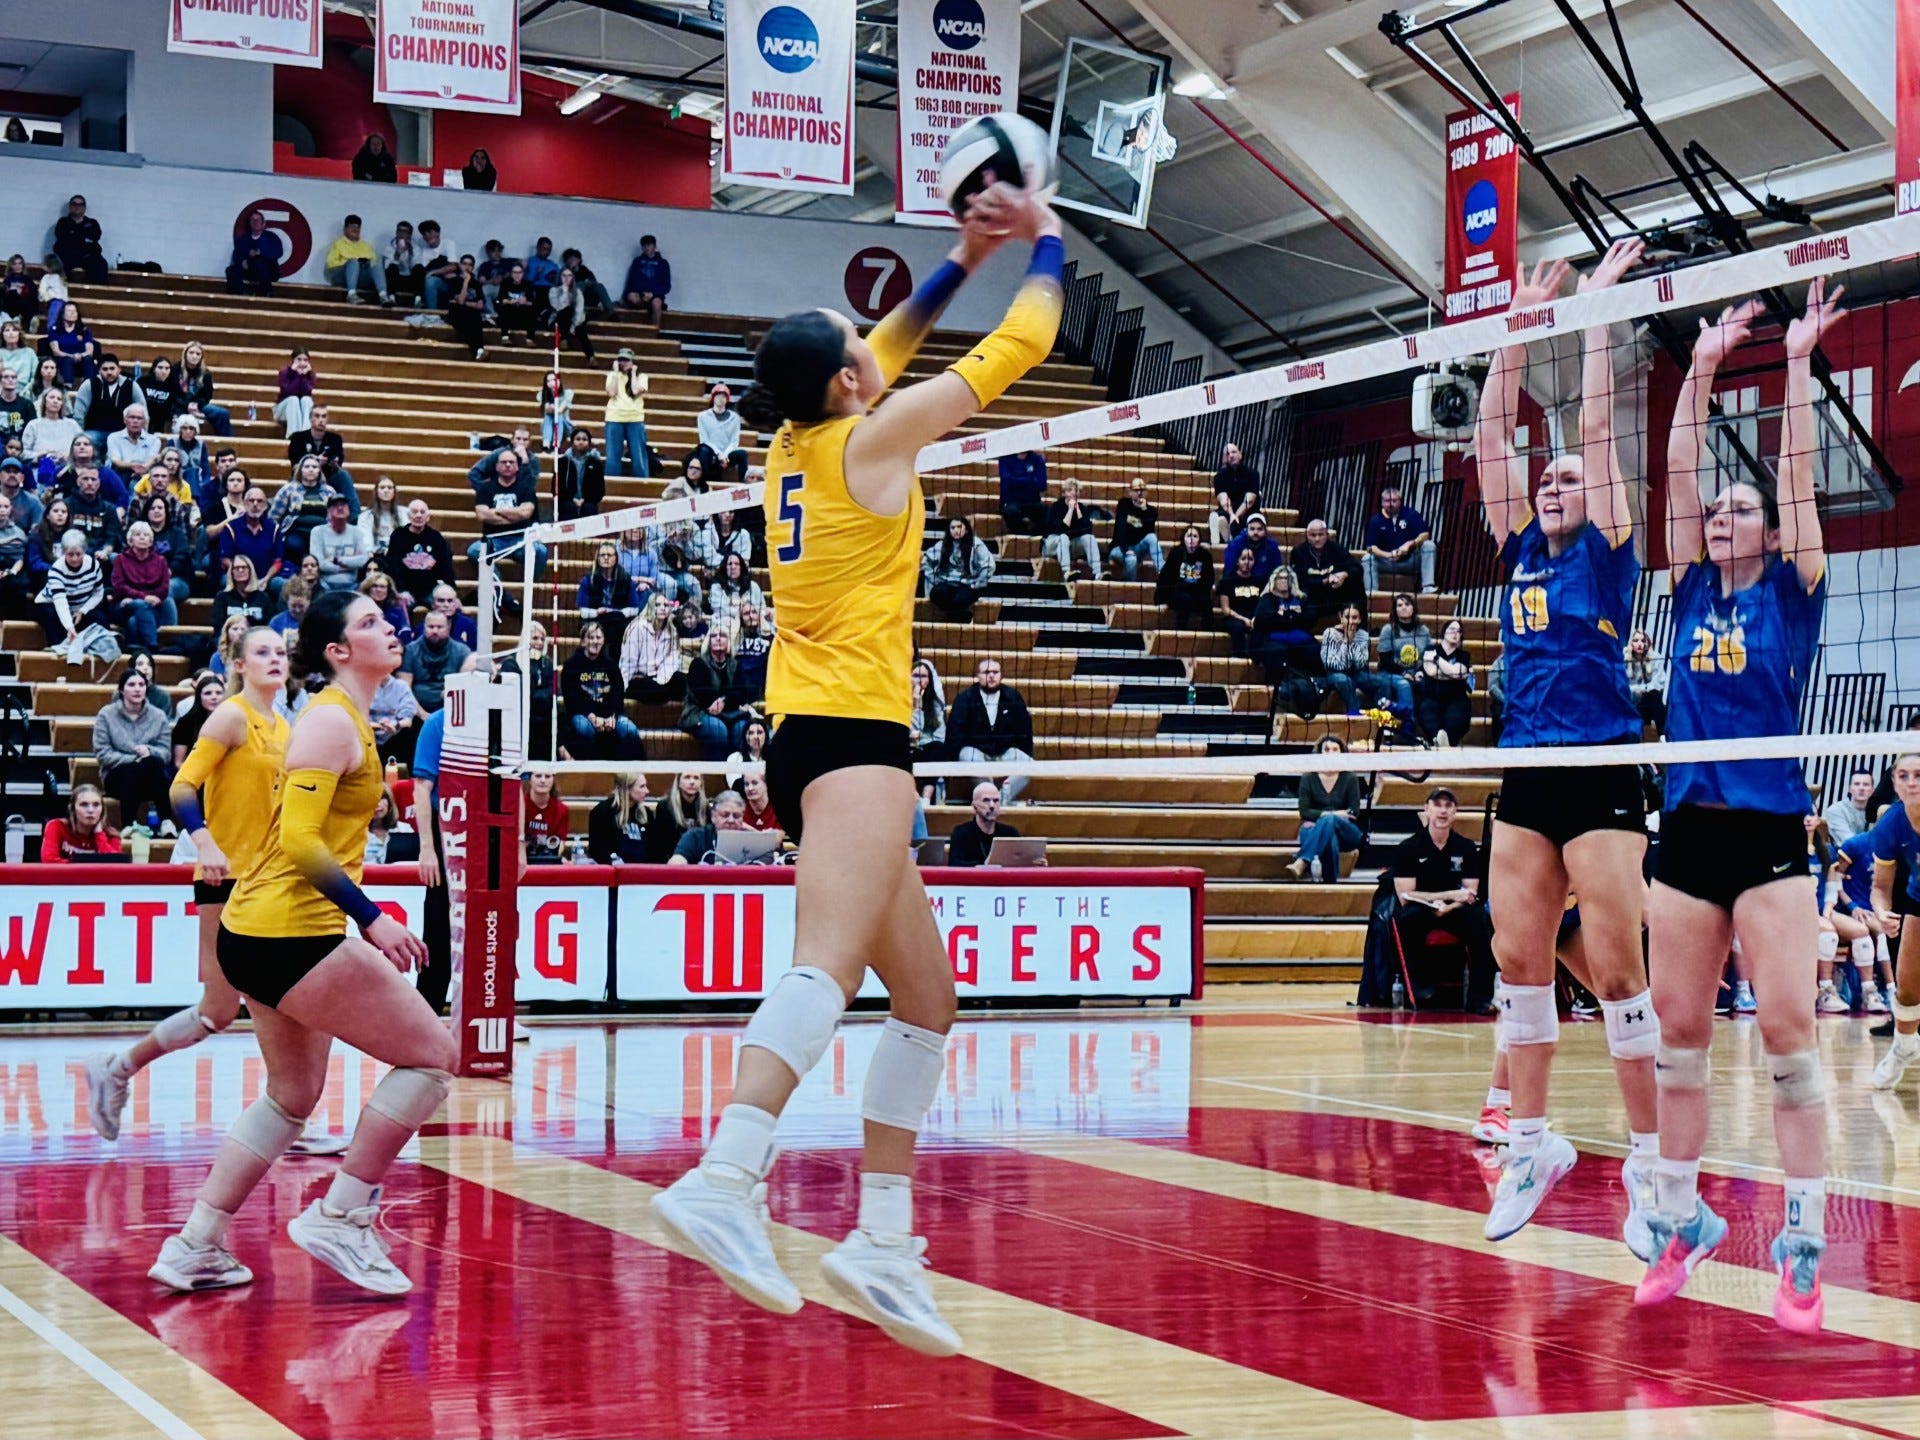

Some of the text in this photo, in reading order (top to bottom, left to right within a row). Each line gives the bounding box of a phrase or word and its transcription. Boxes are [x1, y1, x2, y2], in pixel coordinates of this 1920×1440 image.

[422, 0, 475, 17] NATIONAL
[410, 16, 485, 36] TOURNAMENT
[938, 18, 985, 38] NCAA
[388, 33, 507, 71] CHAMPIONS
[763, 37, 818, 59] NCAA
[931, 51, 987, 71] NATIONAL
[916, 68, 1002, 96] CHAMPIONS
[752, 91, 823, 115] NATIONAL
[915, 97, 939, 112] 1963
[941, 100, 962, 114] BOB
[733, 111, 842, 146] CHAMPIONS
[928, 114, 949, 129] 120Y
[911, 132, 935, 148] 1982
[1451, 142, 1479, 171] 1989
[1465, 207, 1497, 232] NCAA
[256, 209, 293, 267] 5
[862, 257, 897, 310] 7
[1446, 288, 1476, 317] SWEET
[777, 472, 805, 565] 5
[1510, 586, 1550, 635] 19
[1689, 625, 1747, 675] 26
[930, 896, 1110, 918] ME OF THE
[484, 911, 498, 1008] sports imports
[948, 925, 1162, 986] GERS
